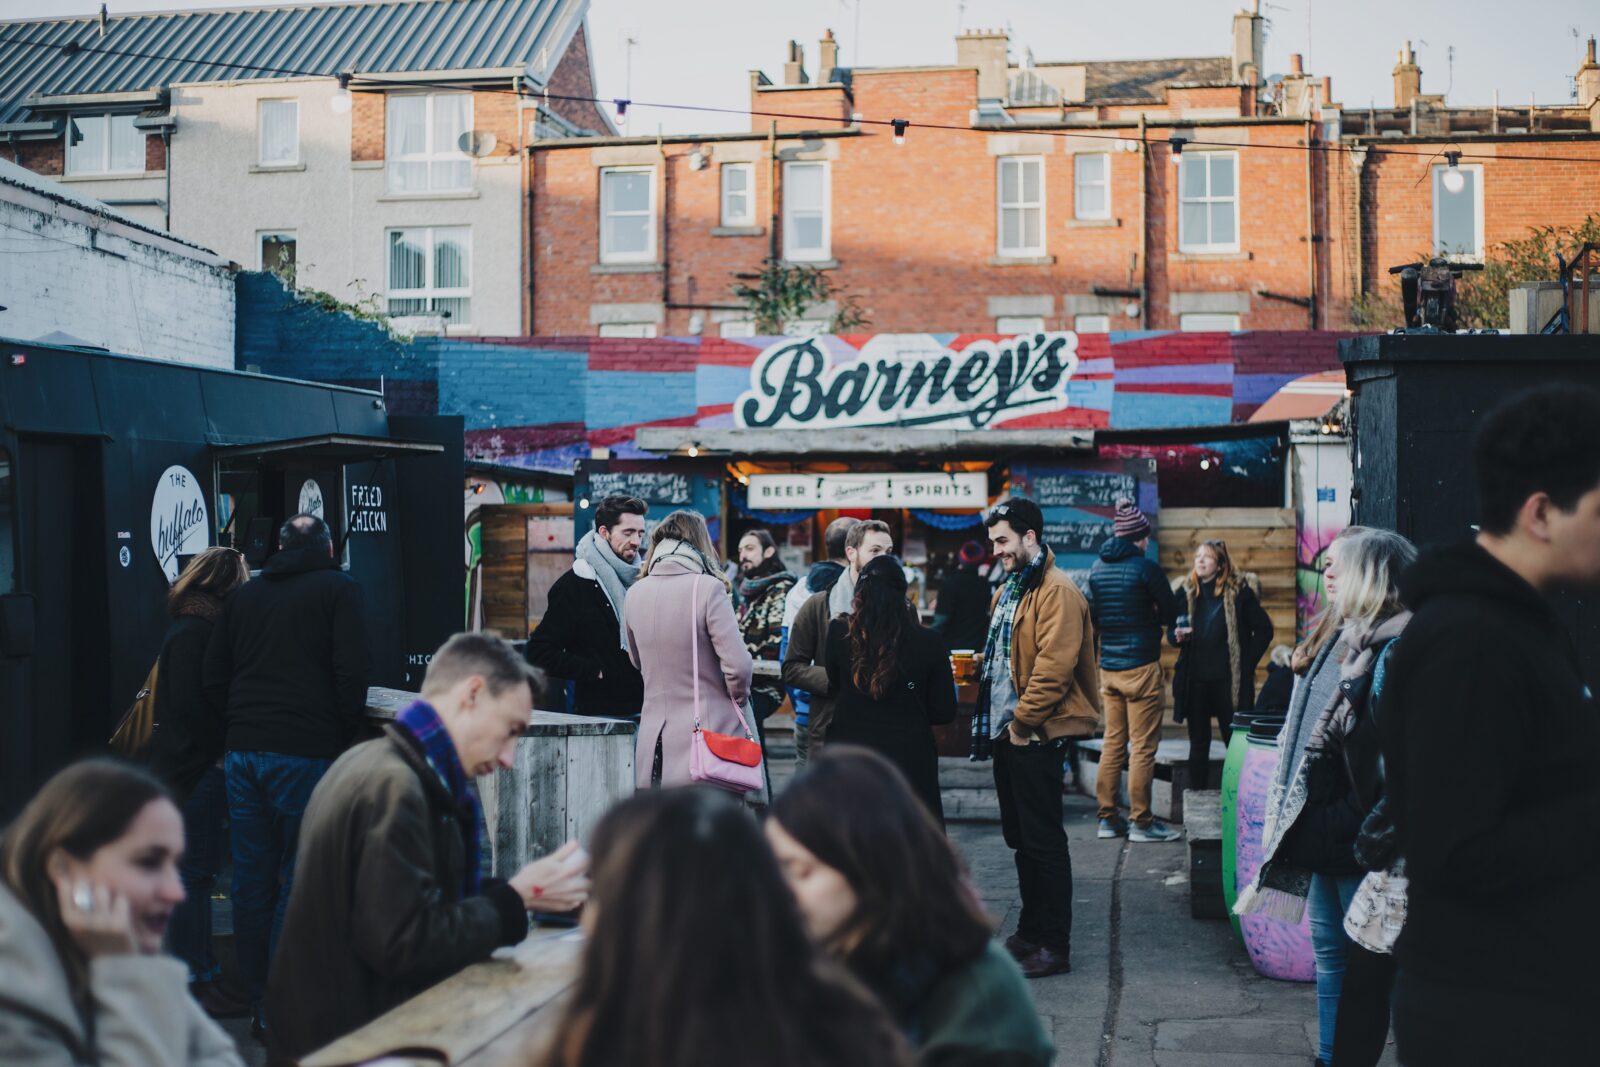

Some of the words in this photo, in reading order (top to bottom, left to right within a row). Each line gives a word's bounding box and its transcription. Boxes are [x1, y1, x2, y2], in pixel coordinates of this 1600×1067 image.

[743, 333, 1068, 428] Barney's
[169, 473, 187, 488] THE
[762, 486, 805, 497] BEER
[903, 485, 971, 496] SPIRITS
[351, 485, 382, 507] FRIED
[158, 498, 204, 562] buffalo
[350, 510, 387, 533] CHICKN
